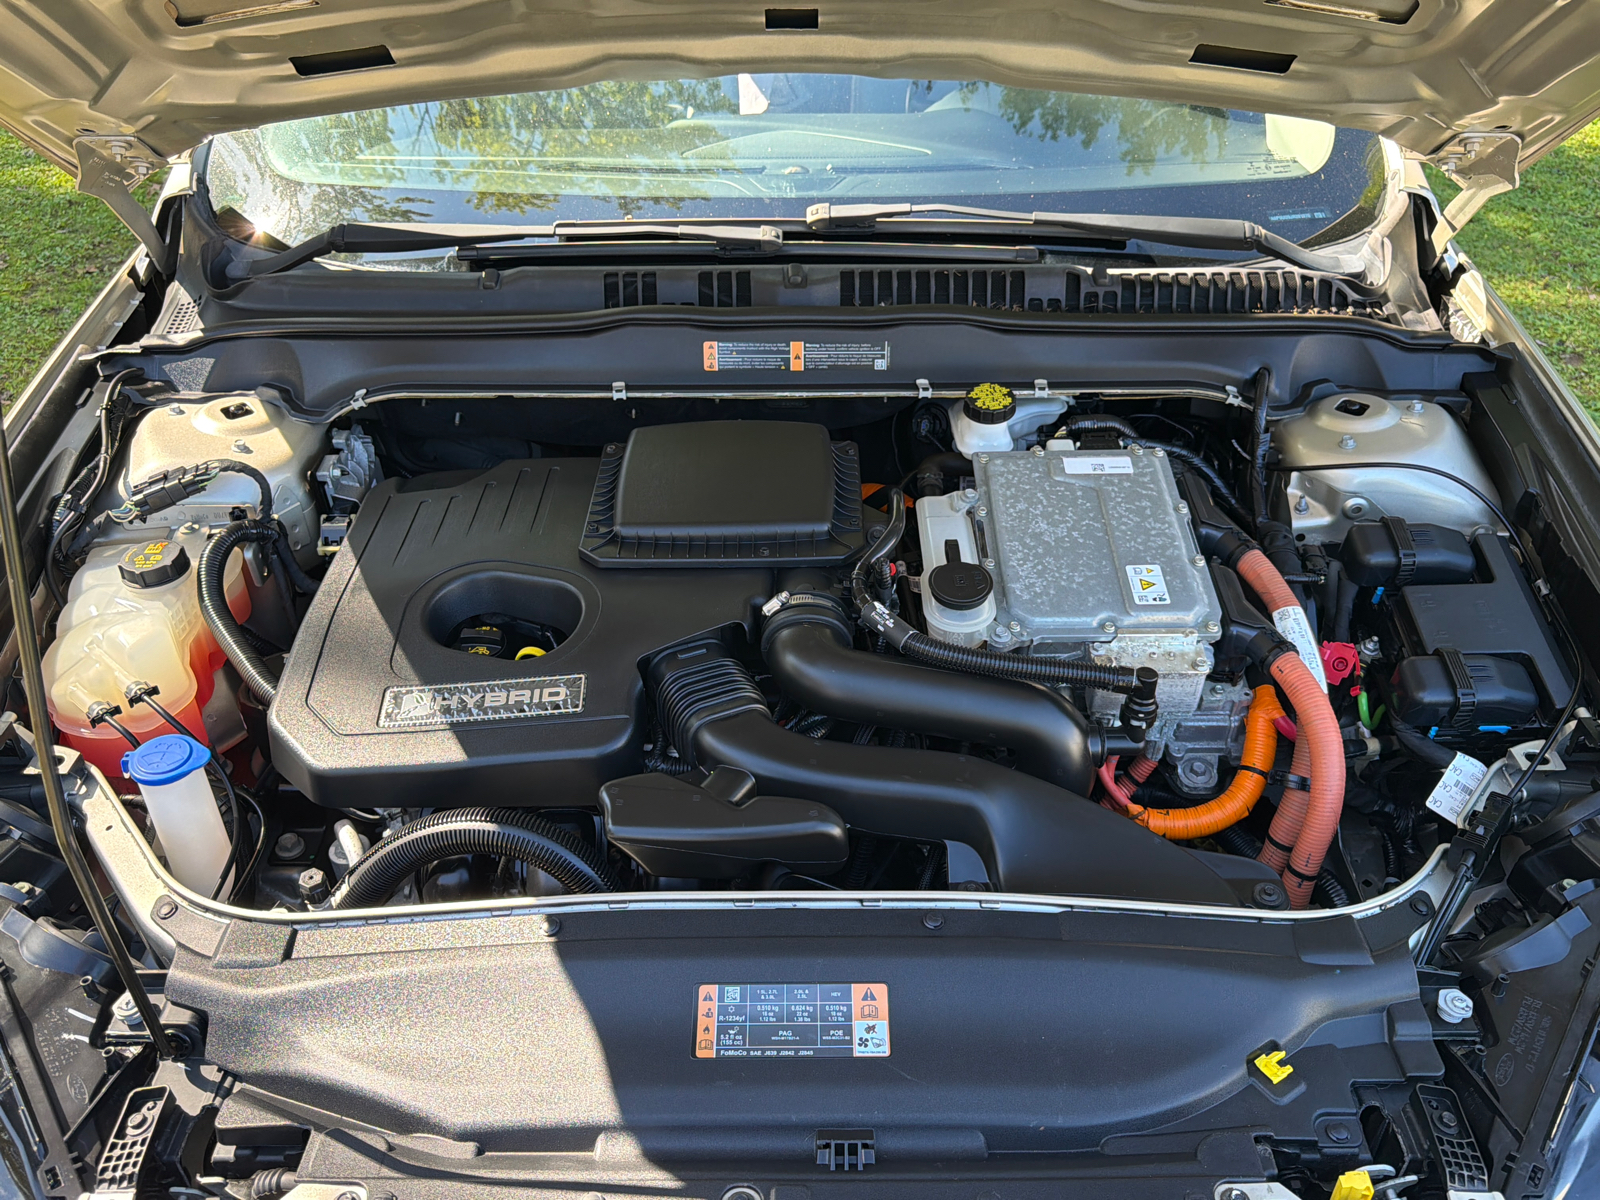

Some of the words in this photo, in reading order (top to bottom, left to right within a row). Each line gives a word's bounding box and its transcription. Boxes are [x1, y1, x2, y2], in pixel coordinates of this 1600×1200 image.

[434, 688, 567, 710] HYBRID
[1439, 780, 1452, 793] CAC
[1428, 796, 1442, 808] CAC
